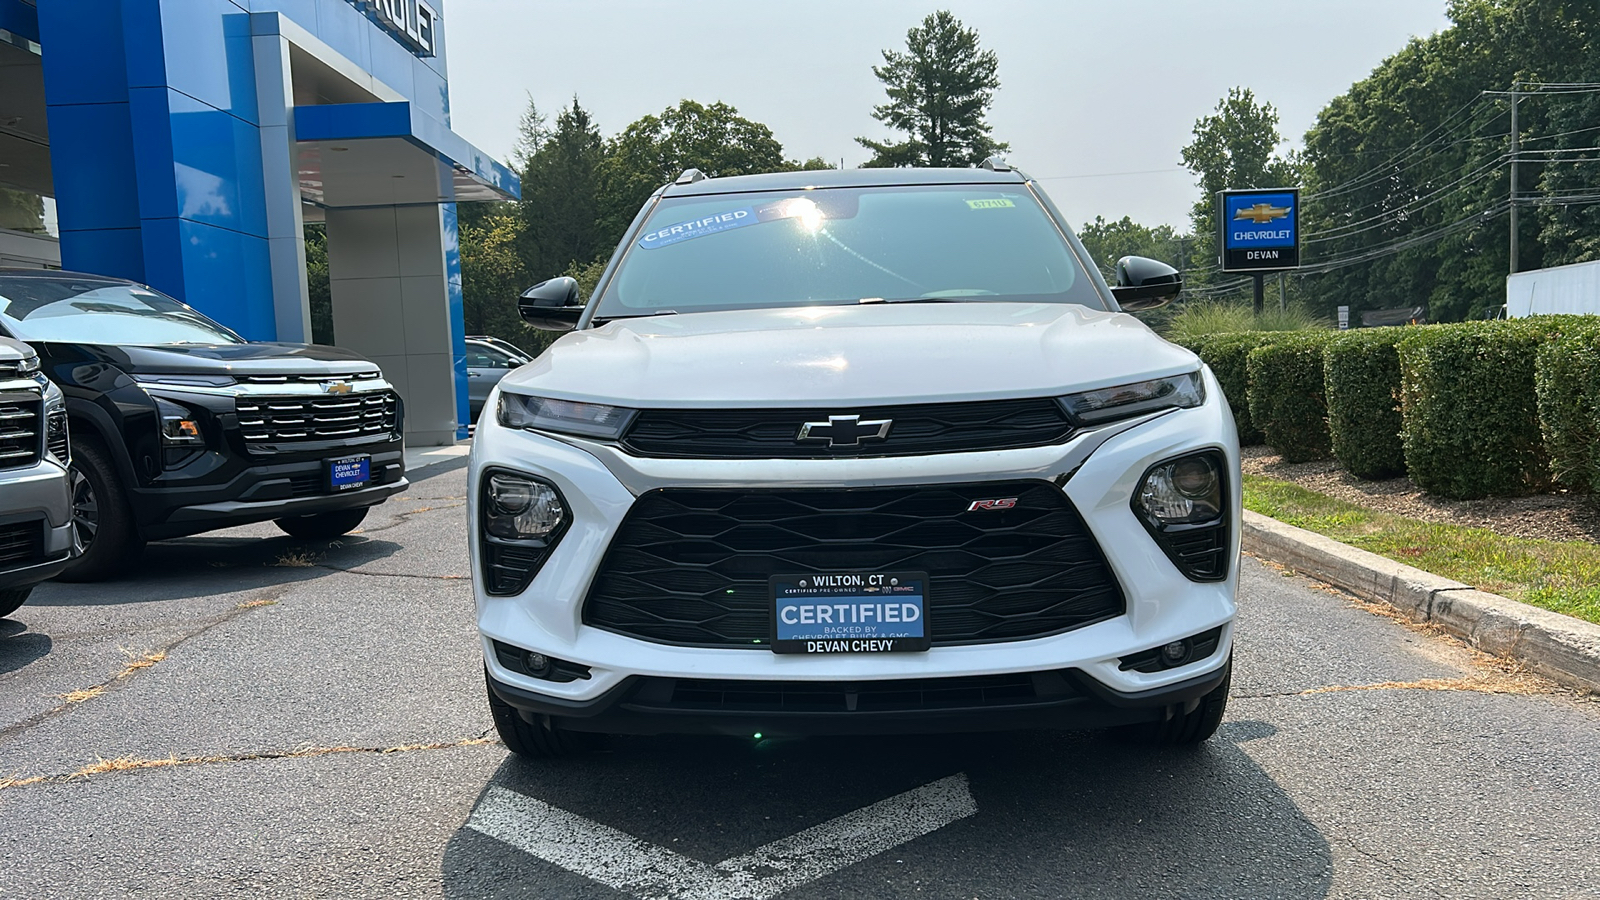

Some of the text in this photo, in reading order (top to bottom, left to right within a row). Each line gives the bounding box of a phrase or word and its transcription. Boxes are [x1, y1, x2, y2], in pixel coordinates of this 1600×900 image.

[644, 211, 748, 242] CERTIFIED
[1234, 230, 1291, 240] CHEVROLET
[1247, 250, 1279, 260] DEVAN
[335, 469, 360, 478] CHEVROLET
[967, 498, 1018, 511] RS
[813, 574, 884, 586] WILTON, CT
[781, 604, 920, 624] CERTIFIED
[824, 626, 862, 634] BACKED
[807, 639, 893, 653] DEVAN CHEVY
